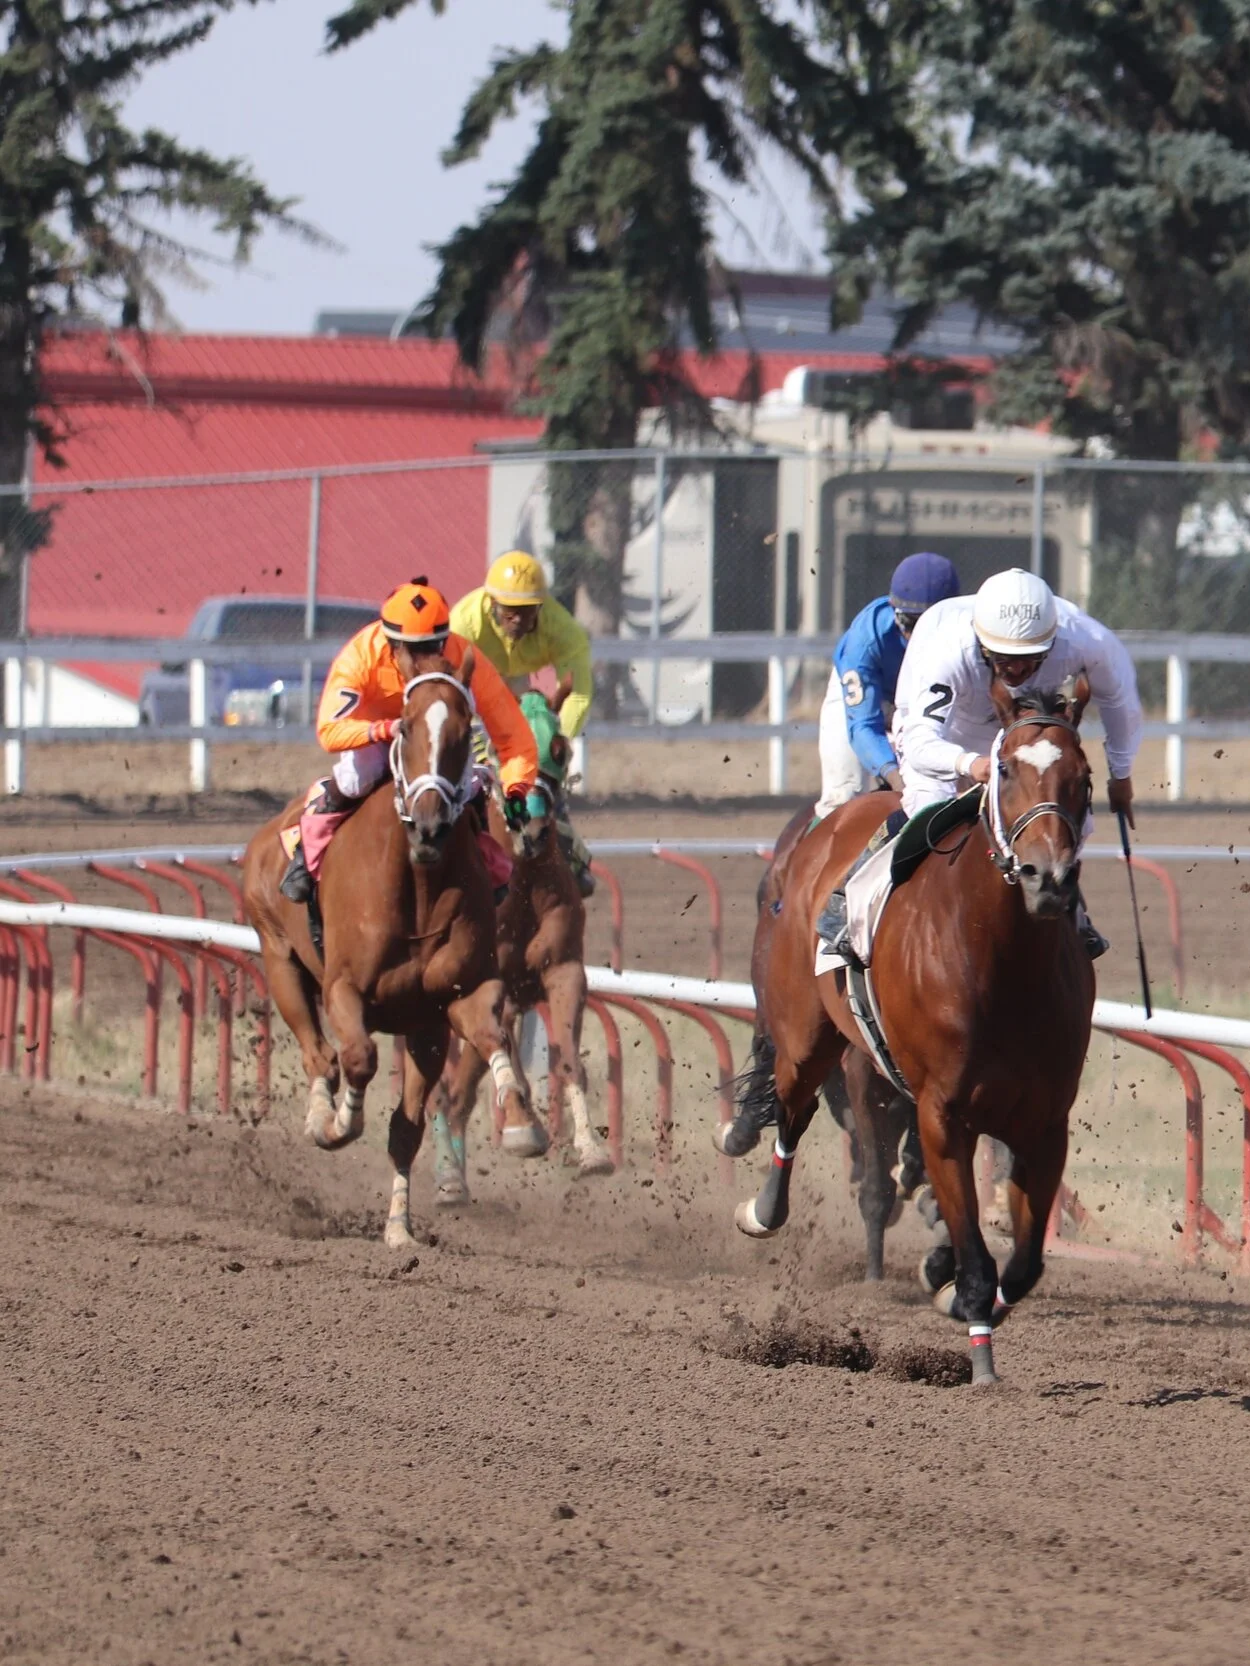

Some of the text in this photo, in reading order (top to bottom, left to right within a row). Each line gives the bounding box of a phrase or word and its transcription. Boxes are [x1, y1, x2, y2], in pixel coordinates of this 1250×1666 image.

[1000, 603, 1041, 621] ROCHA
[334, 690, 360, 719] 7
[841, 670, 864, 707] 3
[923, 683, 953, 724] 2
